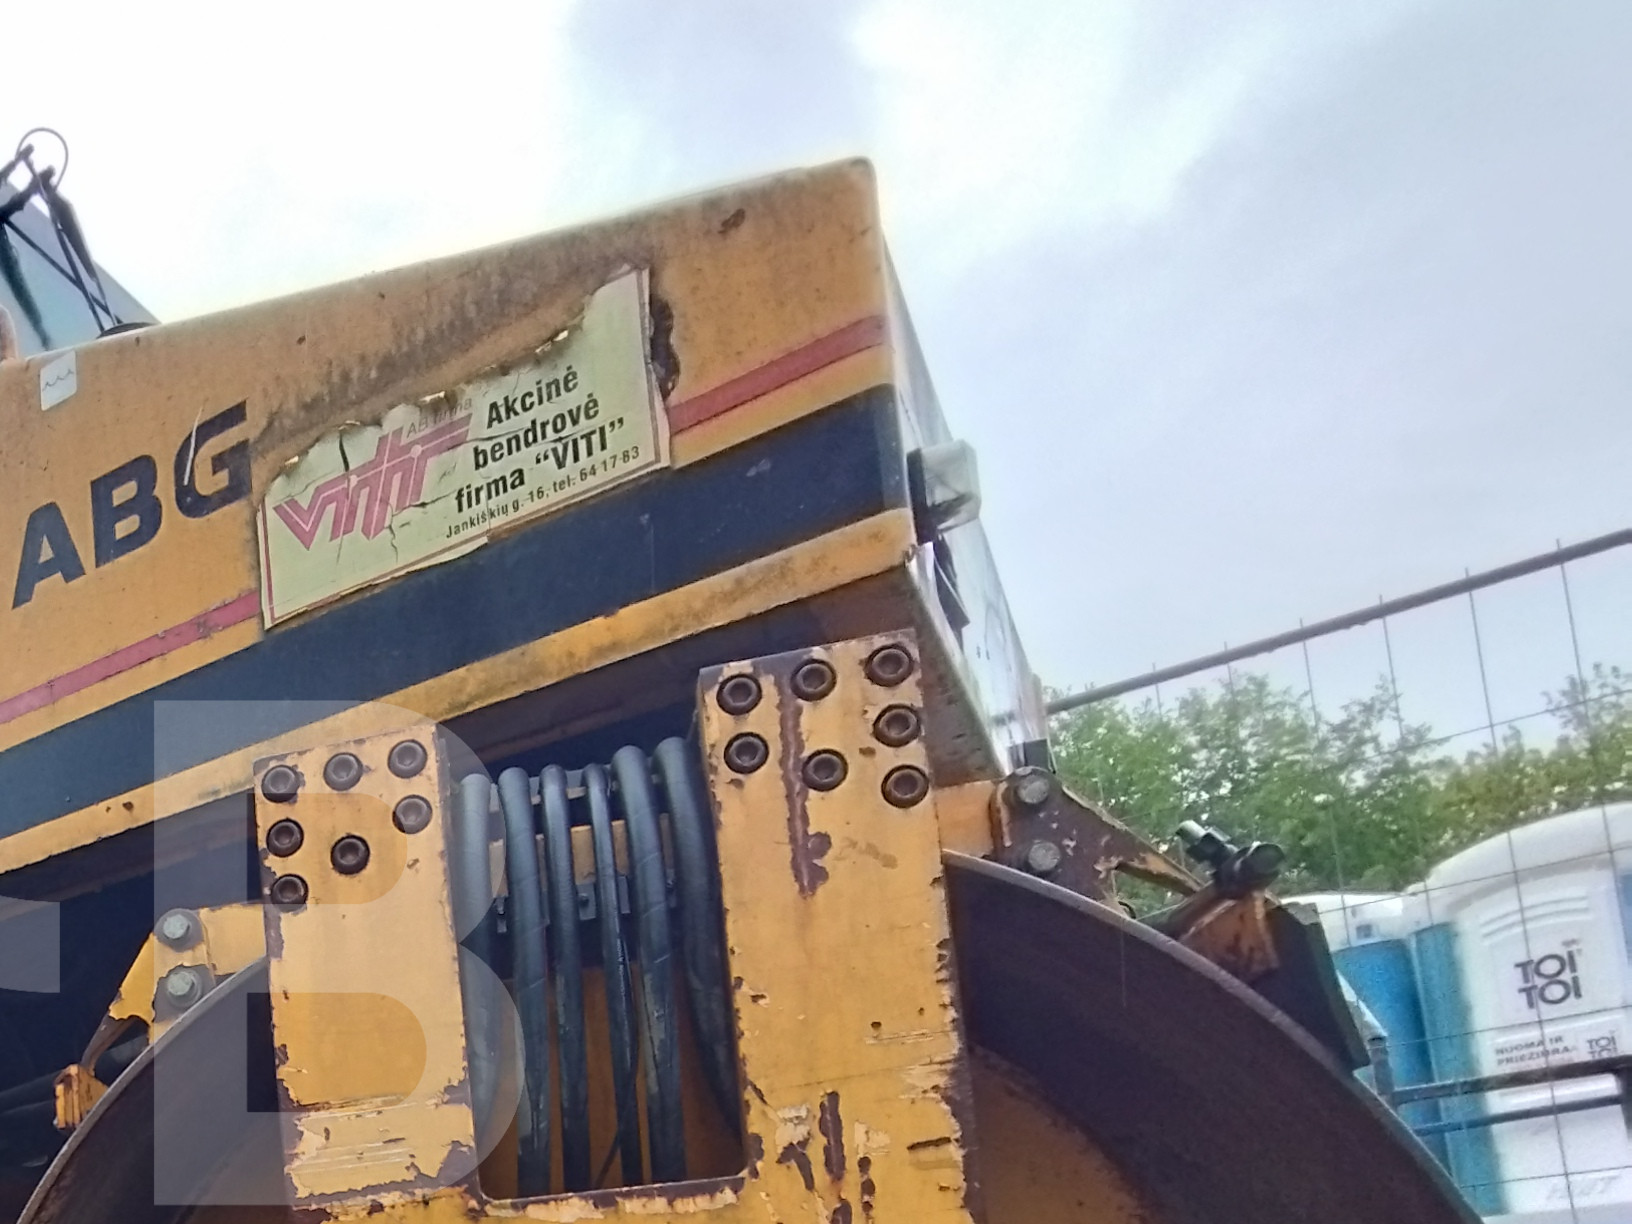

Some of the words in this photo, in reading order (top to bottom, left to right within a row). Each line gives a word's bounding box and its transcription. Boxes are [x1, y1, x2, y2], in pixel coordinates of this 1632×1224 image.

[486, 365, 579, 430] Akcinė
[473, 393, 600, 471] bendrovė
[12, 400, 254, 611] ABG
[455, 467, 526, 514] firma
[1513, 949, 1578, 984] TOI
[1518, 975, 1583, 1010] TOI
